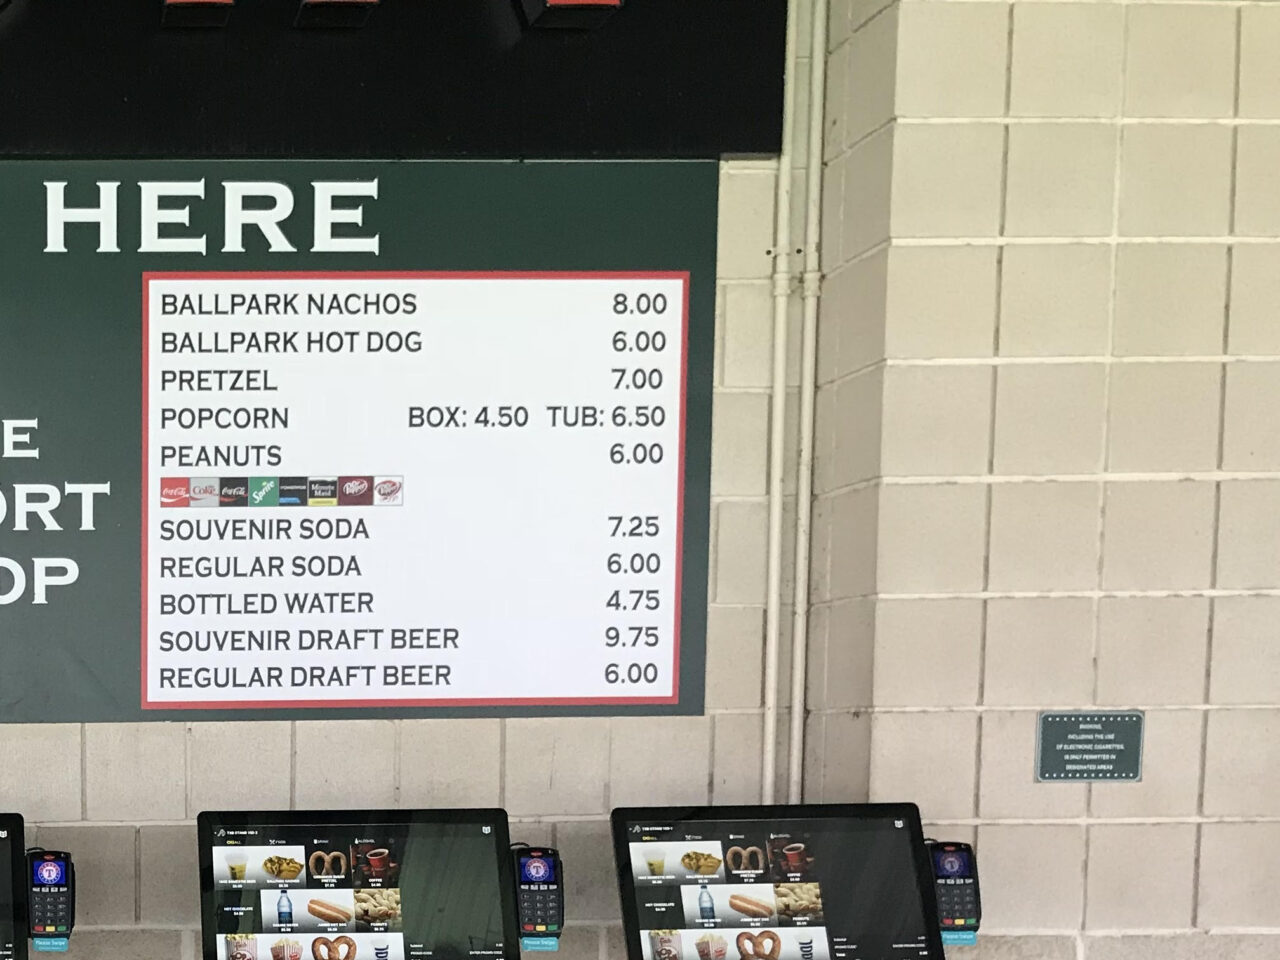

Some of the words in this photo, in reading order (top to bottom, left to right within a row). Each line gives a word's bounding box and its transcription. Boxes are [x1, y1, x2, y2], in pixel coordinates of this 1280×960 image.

[44, 178, 379, 255] HERE
[162, 294, 298, 315] BALLPARK
[308, 293, 416, 314] NACHOS
[613, 293, 667, 314] 8.00
[162, 332, 298, 353] BALLPARK
[308, 332, 359, 352] HOT
[368, 331, 421, 352] DOG
[613, 331, 665, 351] 6.00
[162, 370, 277, 391] PRETZEL
[612, 369, 662, 389] 7.00
[162, 408, 288, 429] POPCORN
[409, 407, 466, 427] BOX:
[475, 406, 528, 427] 4.50
[547, 407, 603, 427] TUB:
[612, 406, 665, 426] 6.50
[162, 445, 281, 466] PEANUTS
[610, 443, 663, 464] 6.00
[252, 481, 275, 504] Sprite
[161, 519, 291, 540] SOUVENIR
[300, 518, 369, 539] SODA
[609, 516, 659, 536] 7.25
[161, 557, 283, 577] REGULAR
[292, 556, 361, 576] SODA
[608, 553, 660, 573] 6.00
[161, 594, 277, 614] BOTTLED
[284, 593, 373, 613] WATER
[607, 590, 659, 610] 4.75
[160, 630, 290, 651] SOUVENIR
[299, 629, 383, 650] DRAFT
[391, 629, 458, 649] BEER
[606, 627, 658, 647] 9.75
[160, 667, 282, 688] REGULAR
[291, 666, 376, 686] DRAFT
[384, 665, 450, 685] BEER
[605, 663, 657, 683] 6.00
